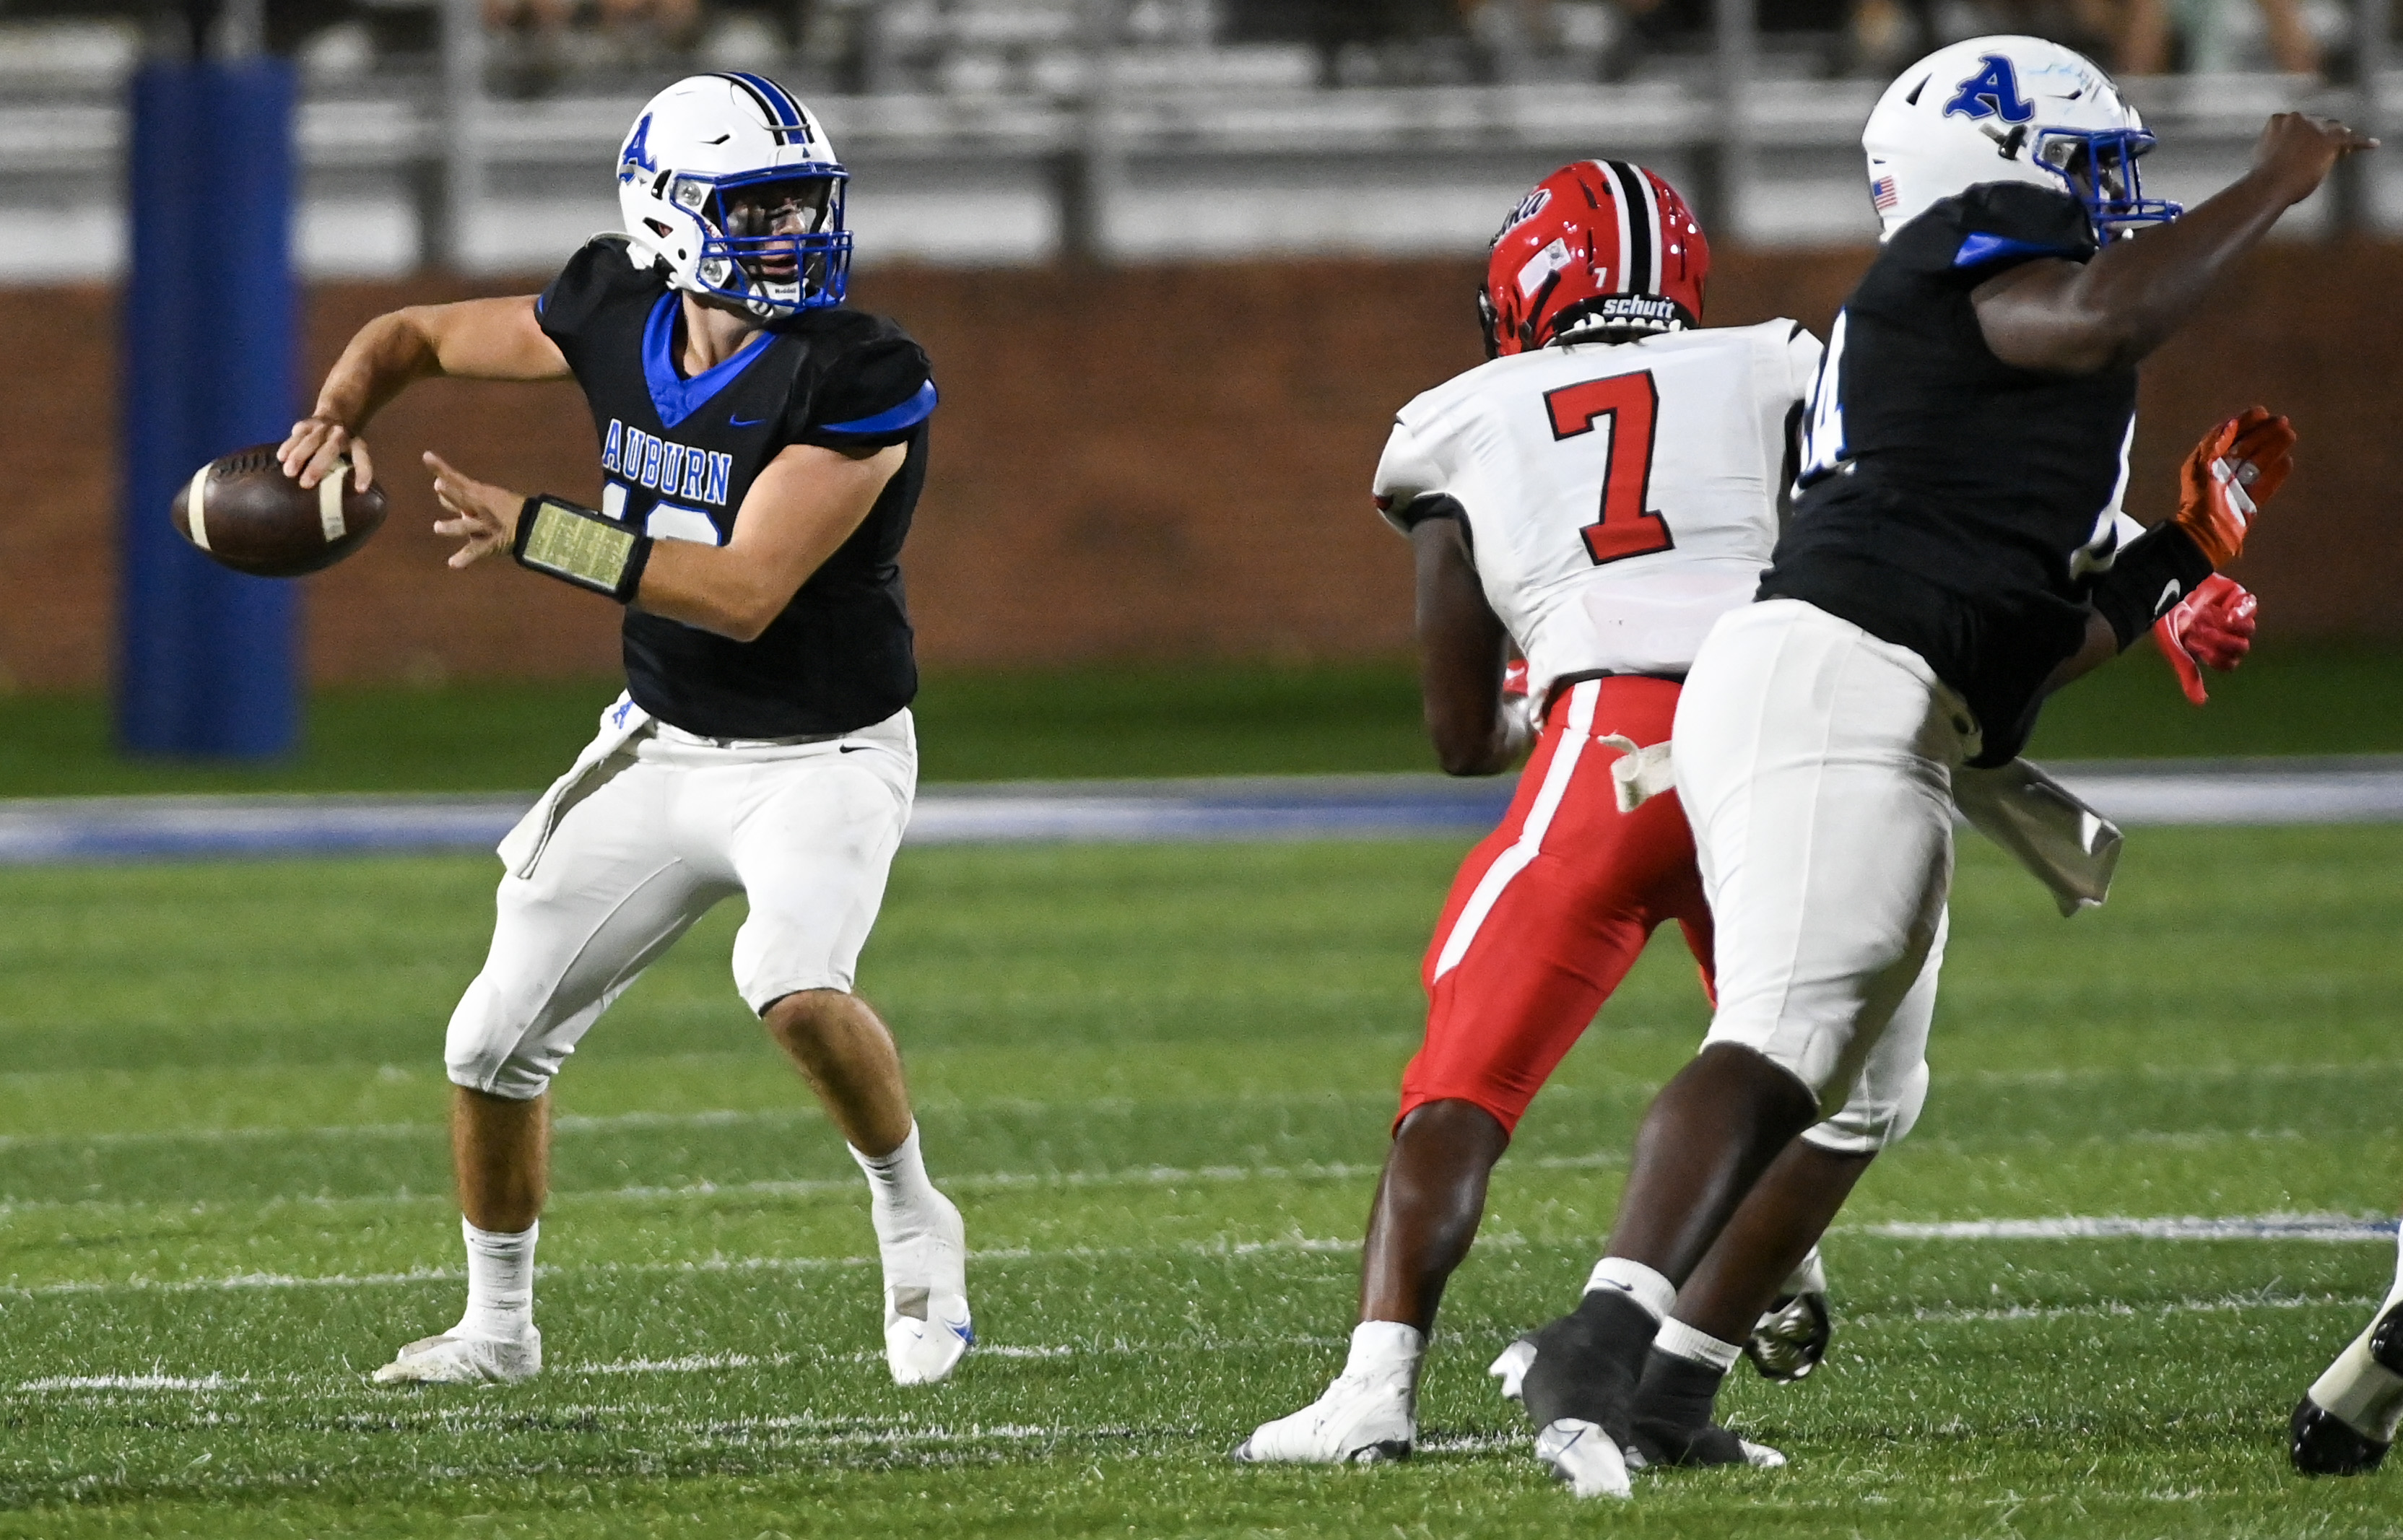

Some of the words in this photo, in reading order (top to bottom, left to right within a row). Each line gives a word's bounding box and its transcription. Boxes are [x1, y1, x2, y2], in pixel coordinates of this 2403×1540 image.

[1942, 54, 2035, 124] A
[619, 111, 658, 186] A
[1594, 267, 1607, 288] 7
[1602, 294, 1674, 318] schutt
[602, 418, 732, 505] AUBURN
[1542, 367, 1676, 566] 7
